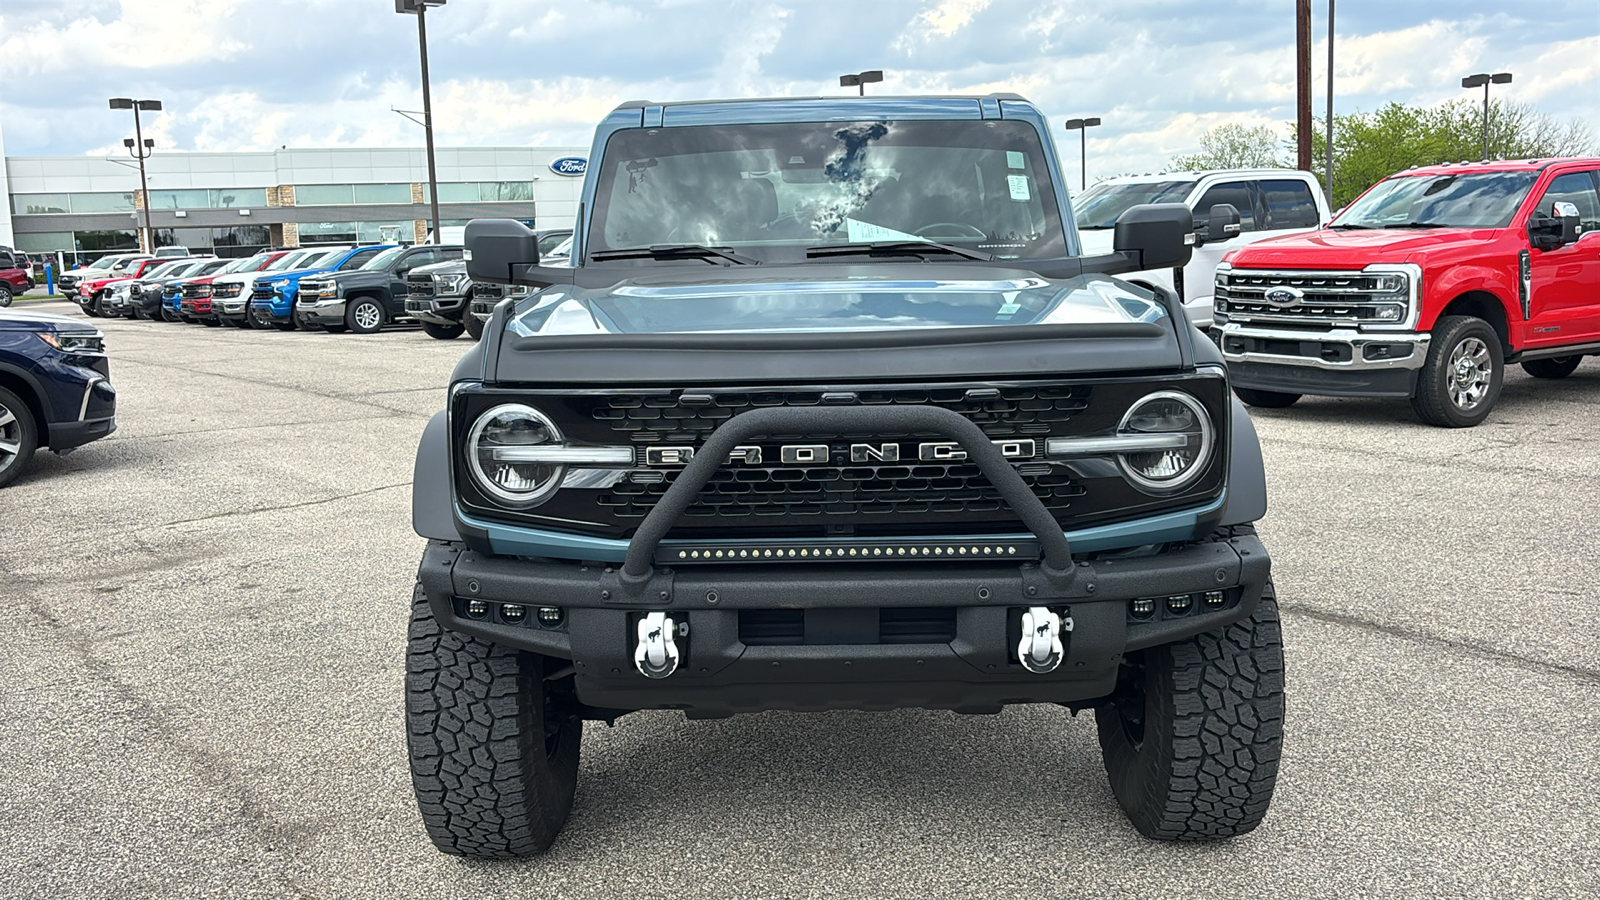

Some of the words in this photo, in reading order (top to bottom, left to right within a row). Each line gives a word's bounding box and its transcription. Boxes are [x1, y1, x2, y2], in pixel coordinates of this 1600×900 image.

[560, 160, 586, 172] Ford
[1271, 291, 1290, 302] Ford
[646, 439, 1036, 466] BRONCO
